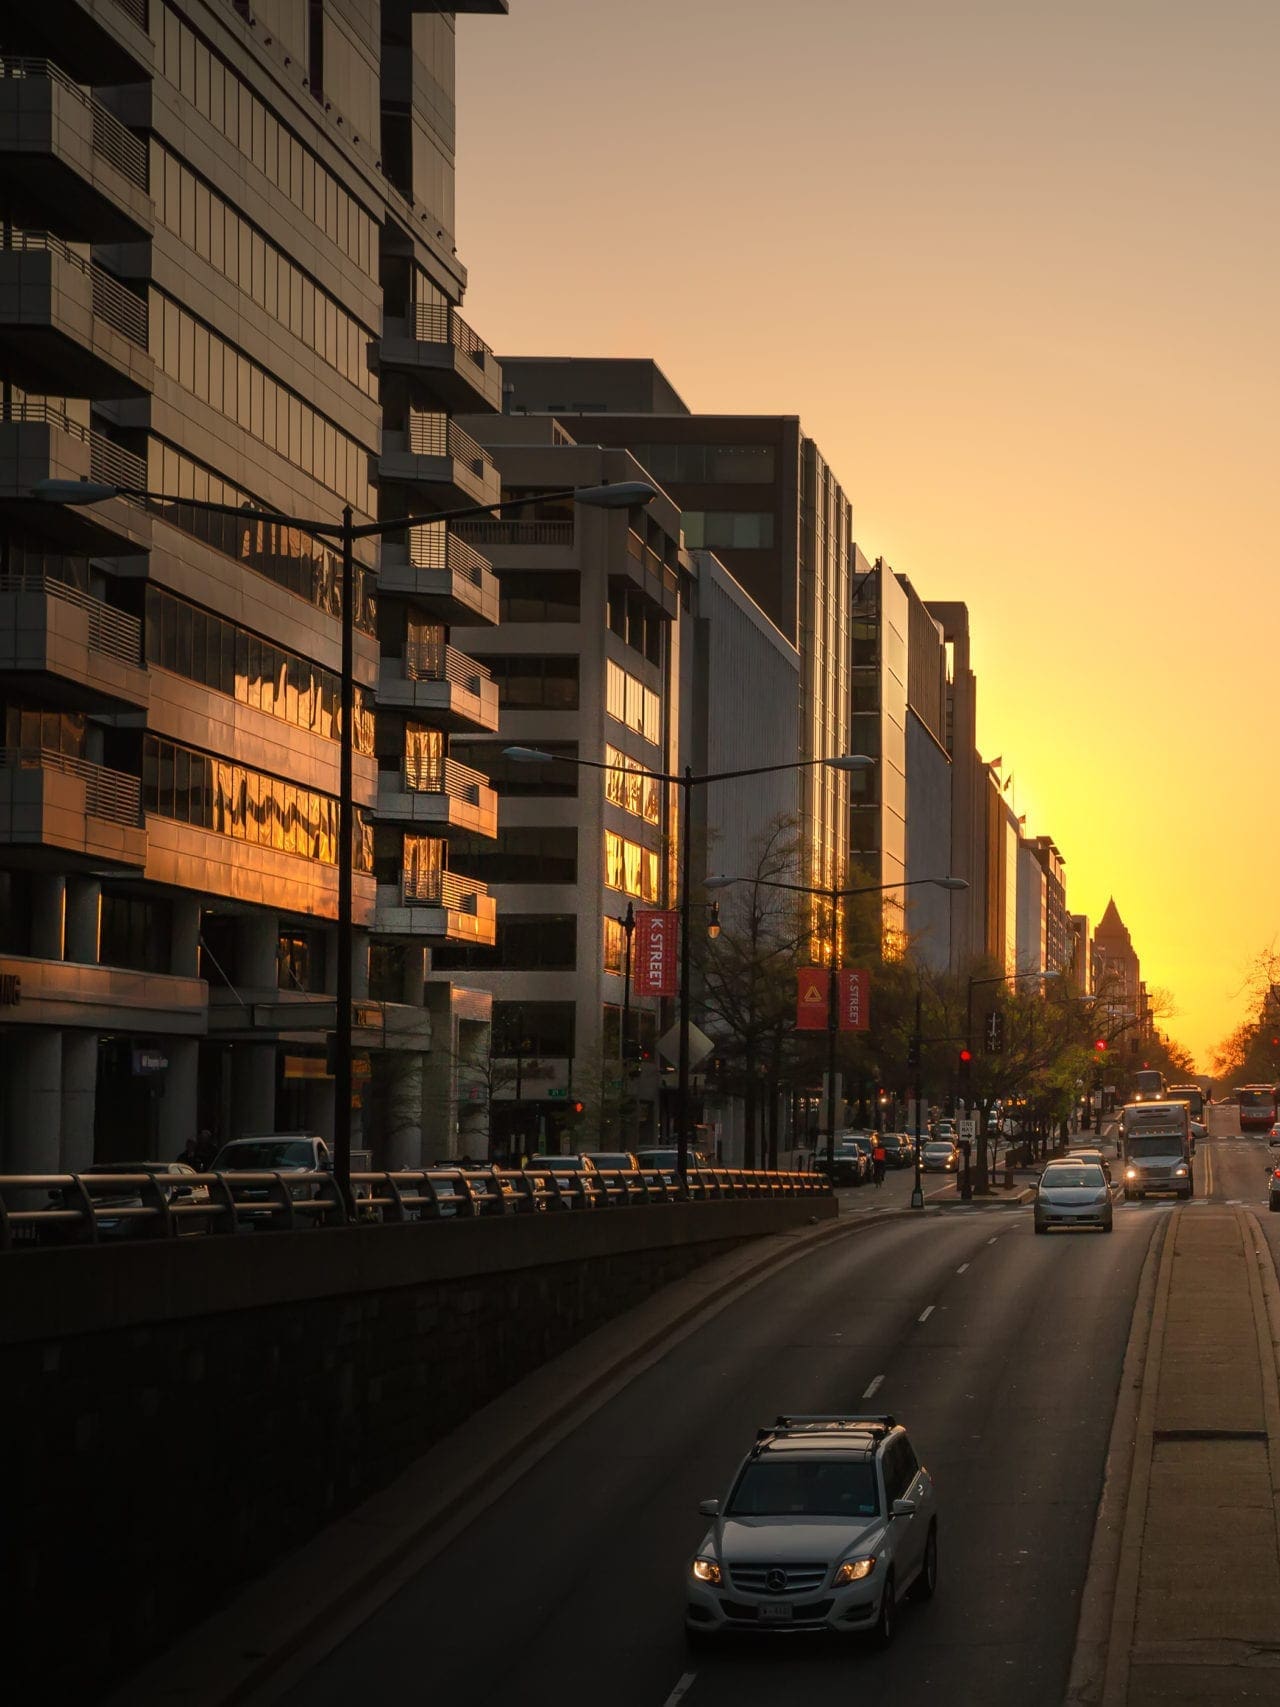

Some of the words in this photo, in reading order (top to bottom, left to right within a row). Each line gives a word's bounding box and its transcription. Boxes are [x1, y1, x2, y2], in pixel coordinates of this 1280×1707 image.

[650, 918, 664, 929] K
[649, 934, 663, 988] STREET
[849, 974, 859, 983] K
[848, 985, 859, 1025] STREET
